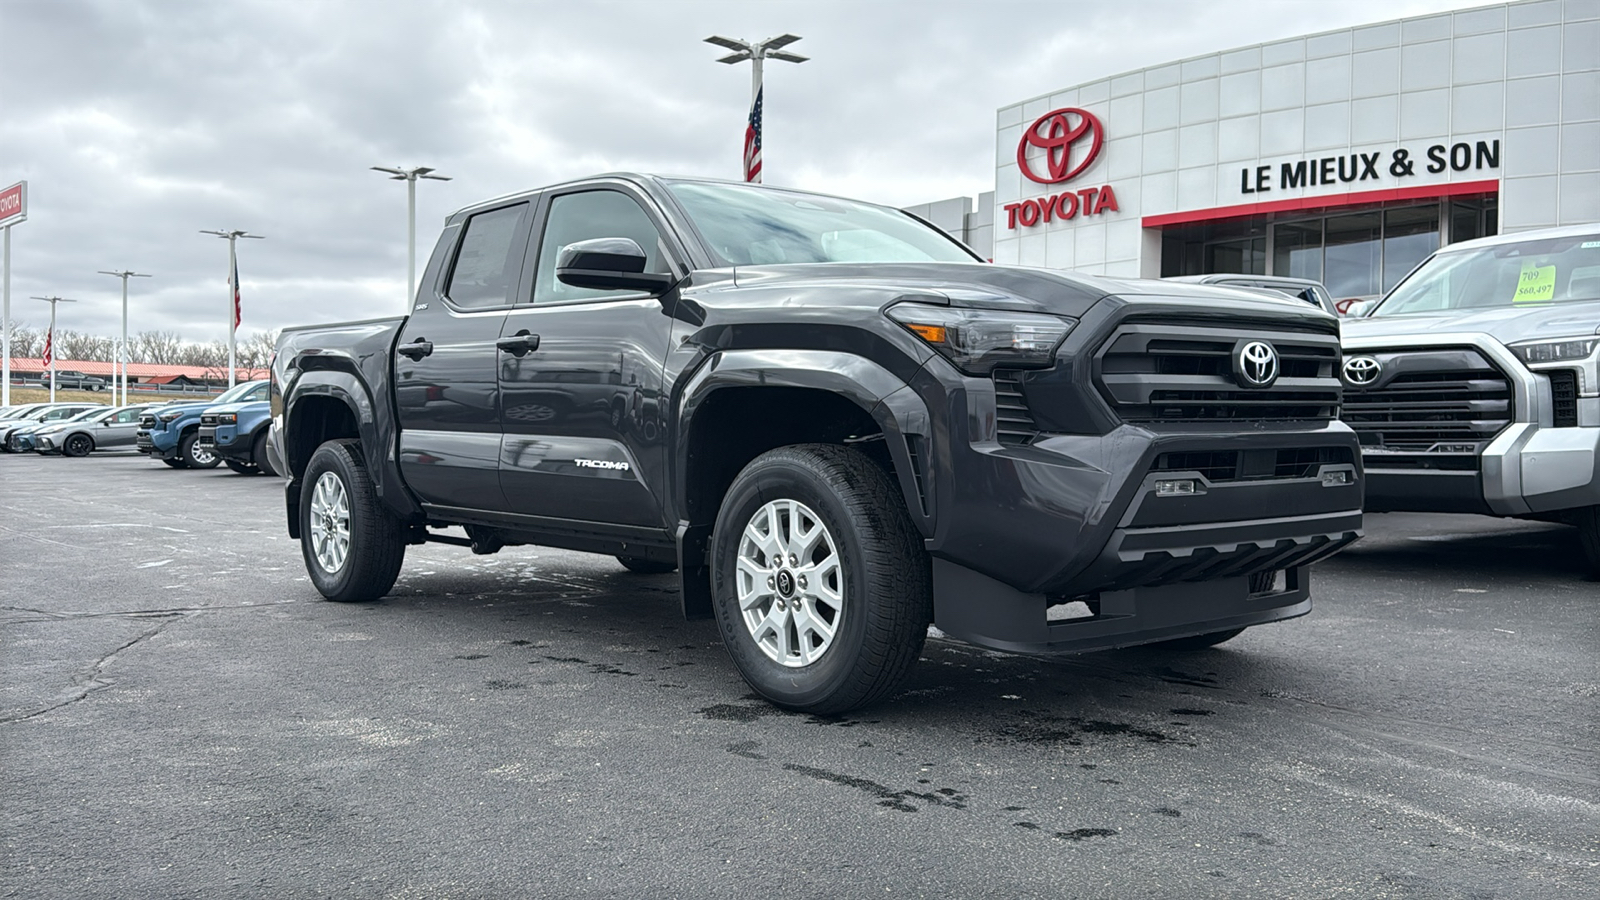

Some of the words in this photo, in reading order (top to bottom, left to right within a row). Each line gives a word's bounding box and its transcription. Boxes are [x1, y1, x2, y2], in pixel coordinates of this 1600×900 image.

[1241, 165, 1271, 194] LE
[1280, 152, 1381, 190] MIEUX
[1389, 148, 1415, 177] &
[1427, 139, 1500, 173] SON
[0, 193, 20, 213] OYOTA
[1004, 185, 1118, 229] TOYOTA
[1522, 271, 1540, 281] 709
[1518, 284, 1552, 295] $60,497
[574, 458, 629, 471] TACOMA
